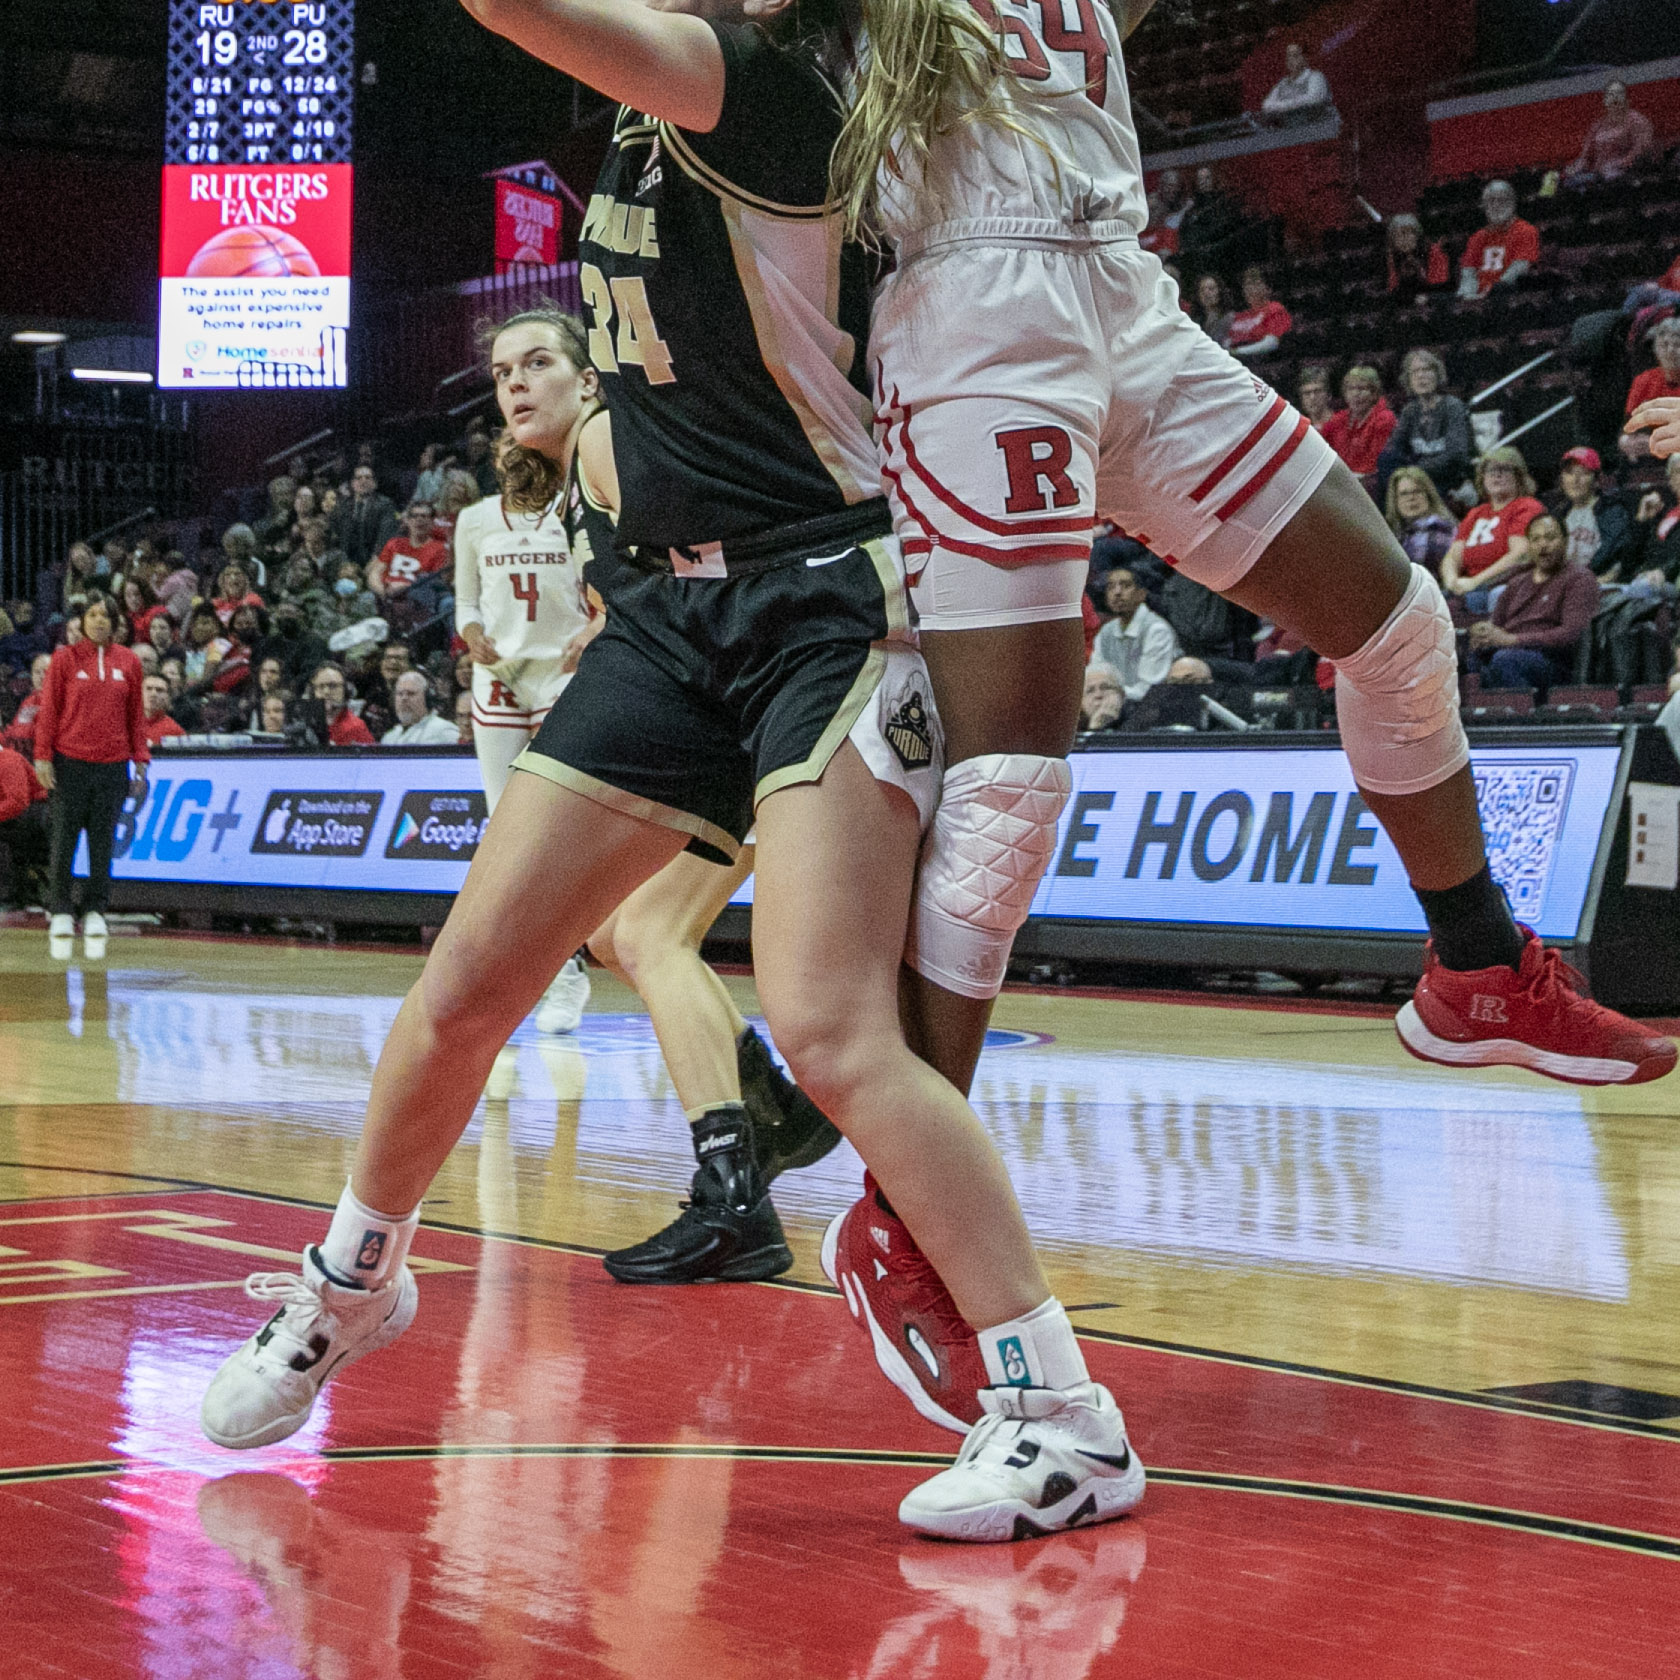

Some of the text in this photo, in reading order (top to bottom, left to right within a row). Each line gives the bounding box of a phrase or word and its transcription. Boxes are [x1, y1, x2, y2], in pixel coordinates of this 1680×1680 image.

[199, 4, 326, 28] RU PU
[195, 29, 328, 66] 19 2ND 28
[281, 75, 338, 95] 12/24
[190, 173, 329, 201] RUTGERS
[221, 198, 298, 226] FANS
[182, 286, 331, 299] The assist you need
[187, 303, 324, 317] against expensive
[202, 319, 303, 331] home repairs
[579, 262, 677, 386] 34
[994, 424, 1081, 515] R
[1466, 516, 1501, 547] R
[389, 553, 422, 582] R
[484, 551, 567, 568] RUTGERS
[508, 572, 540, 623] 4
[286, 818, 364, 851] App Store
[421, 816, 480, 852] Google
[1124, 789, 1382, 887] HOME
[1469, 993, 1510, 1024] R
